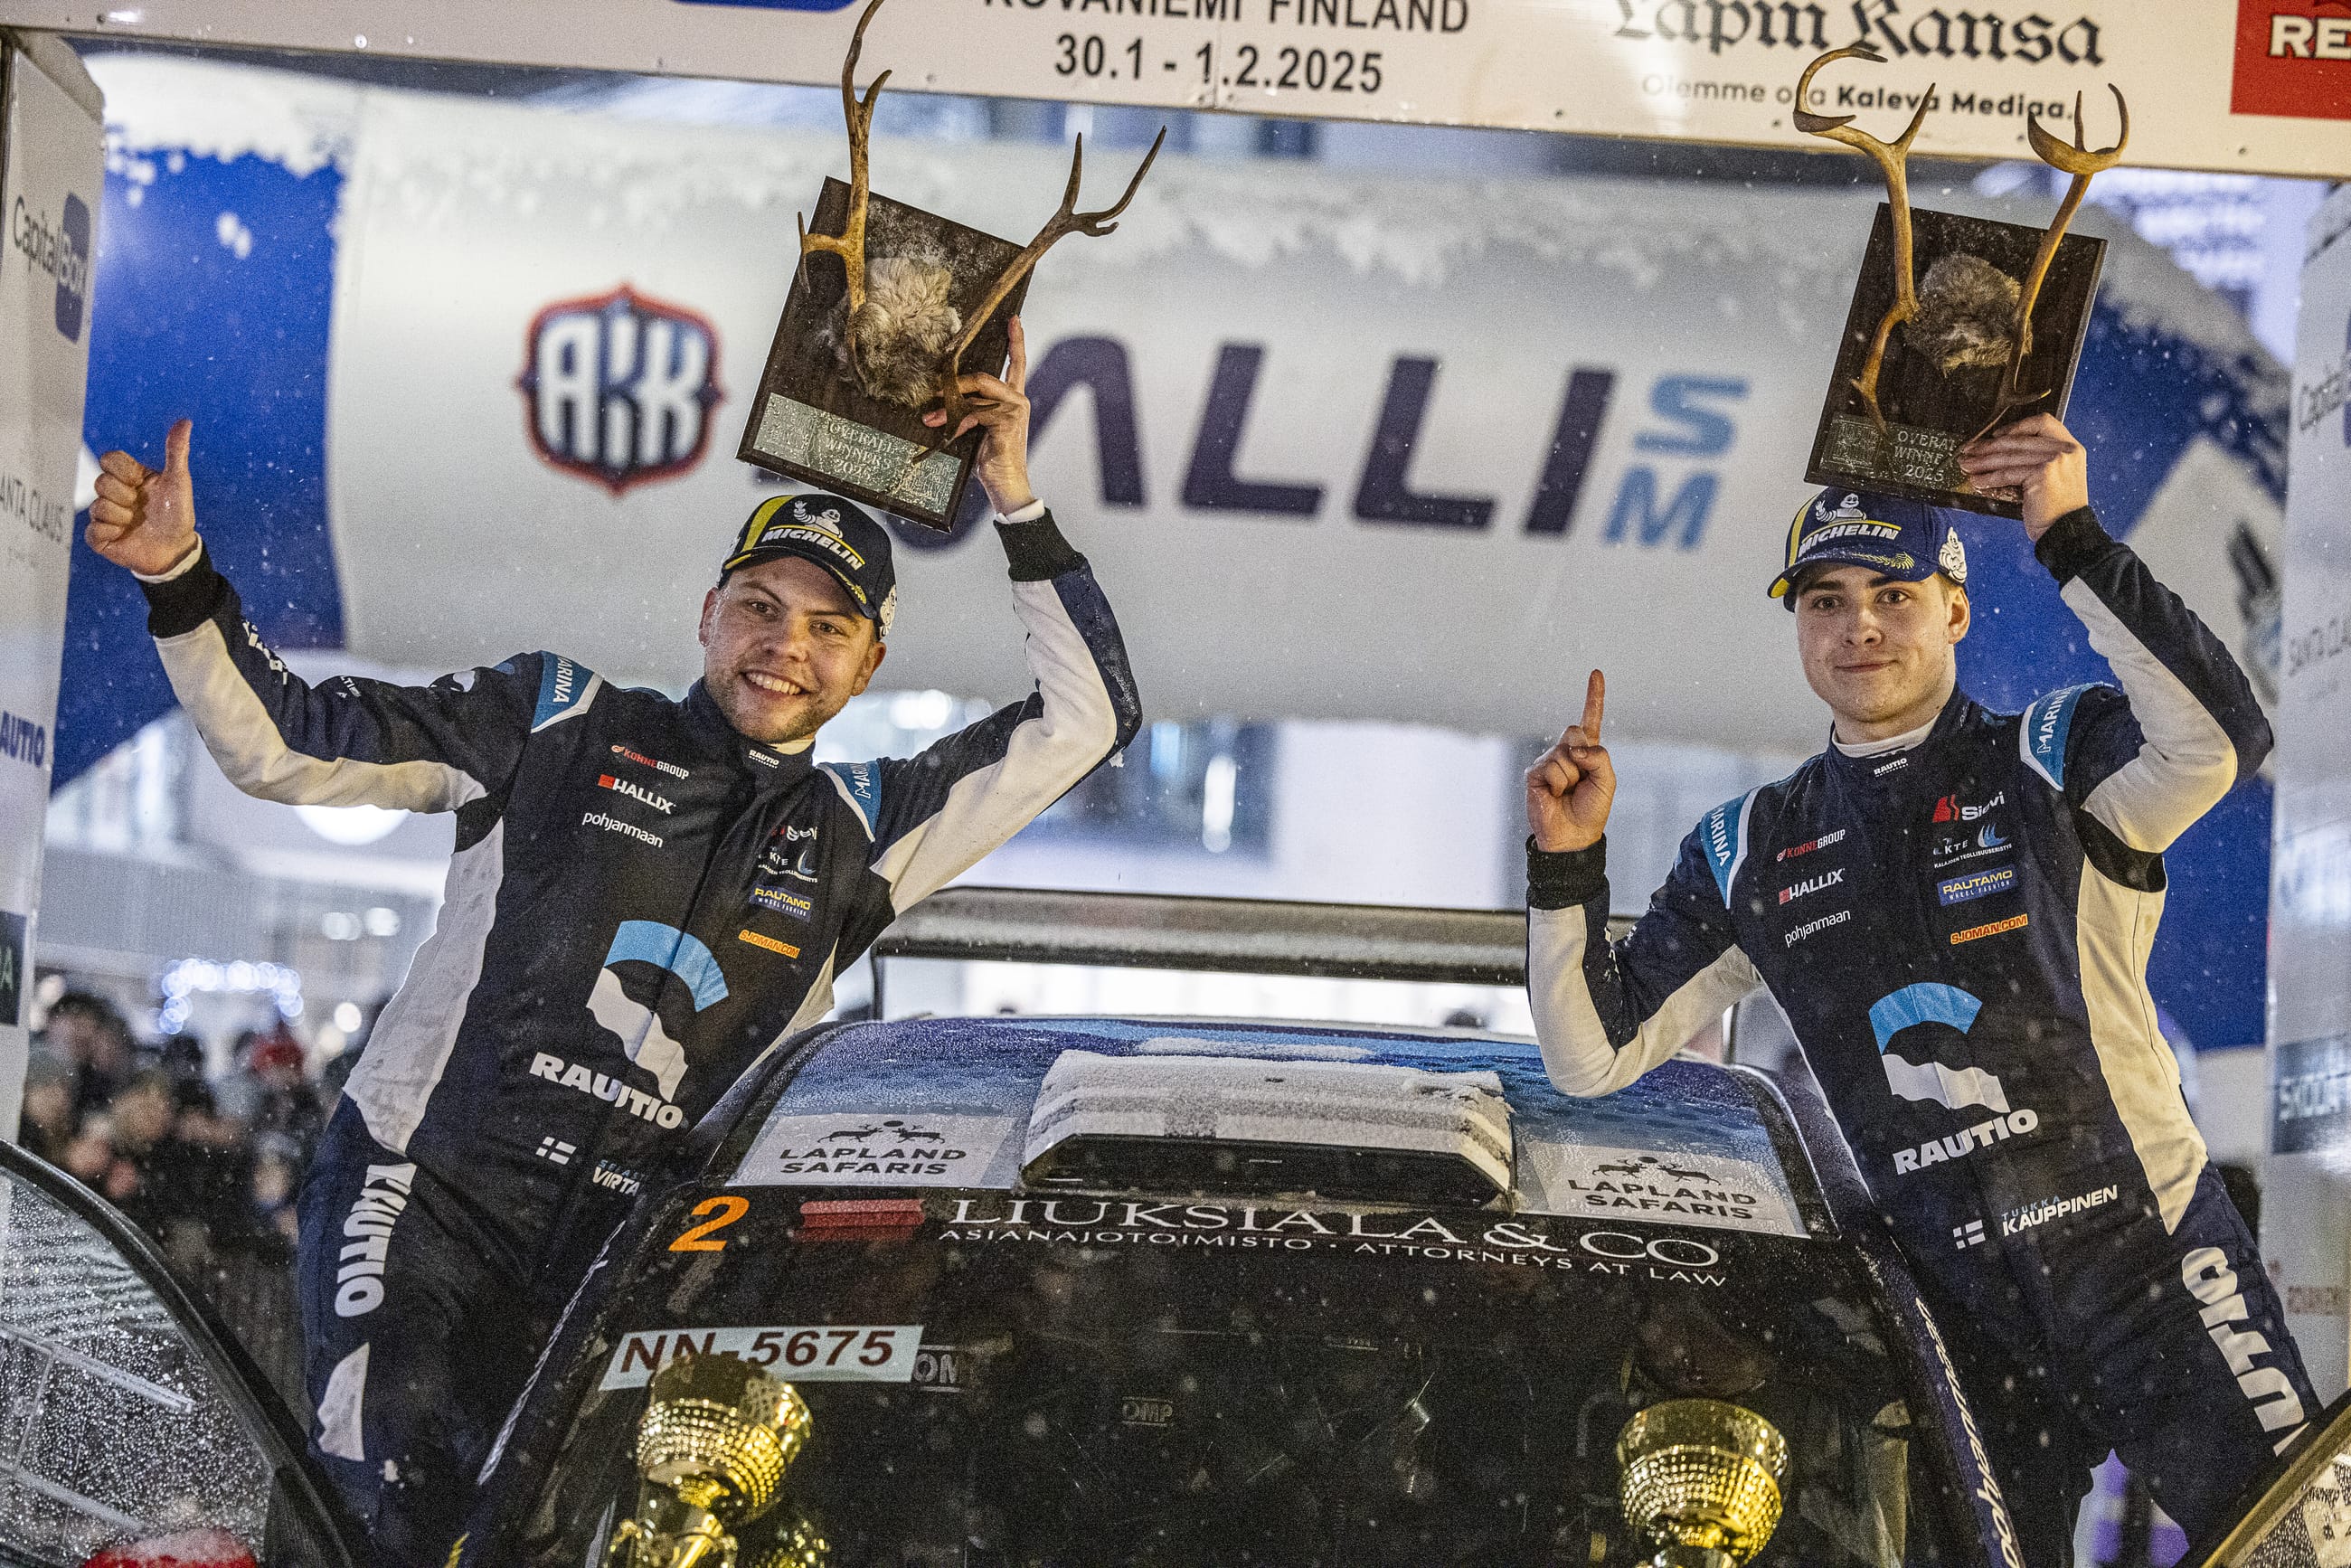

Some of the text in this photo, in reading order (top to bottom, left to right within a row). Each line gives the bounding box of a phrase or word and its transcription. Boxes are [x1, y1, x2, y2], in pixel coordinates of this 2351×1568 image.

[1846, 0, 2105, 67] Kansa
[1055, 33, 1142, 80] 30.1
[1195, 41, 1383, 92] 1.2.2025
[1776, 86, 1844, 107] oa
[540, 306, 713, 467] AKK
[1903, 463, 1945, 483] 2025
[761, 527, 864, 571] MICHELIN
[1798, 524, 1900, 558] MICHELIN
[749, 749, 780, 766] RAUTIO
[1874, 757, 1908, 775] RAUTIO
[612, 778, 675, 815] HALLIX
[581, 812, 664, 848] pohjanmaan
[1944, 839, 1969, 855] KTE
[754, 887, 811, 911] RAUTAMO
[1789, 868, 1846, 901] HALLIX
[1942, 869, 2014, 895] RAUTAMO
[1784, 909, 1851, 949] pohjanmaan
[529, 1051, 684, 1129] RAUTIO
[779, 1148, 967, 1160] LAPLAND
[1893, 1109, 2039, 1176] RAUTIO
[779, 1162, 949, 1175] SAFARIS
[1568, 1179, 1757, 1205] LAPLAND
[1585, 1194, 1753, 1220] SAFARIS
[2001, 1195, 2062, 1221] TUUKKA
[668, 1195, 751, 1252] 2
[2002, 1184, 2119, 1237] KAUPPINEN
[949, 1198, 1720, 1267] LIUKSIALA & CO
[938, 1228, 1727, 1288] ASIANAJOTOIMISTO ATTORNEYS AT LAW
[620, 1329, 897, 1374] NN-5675
